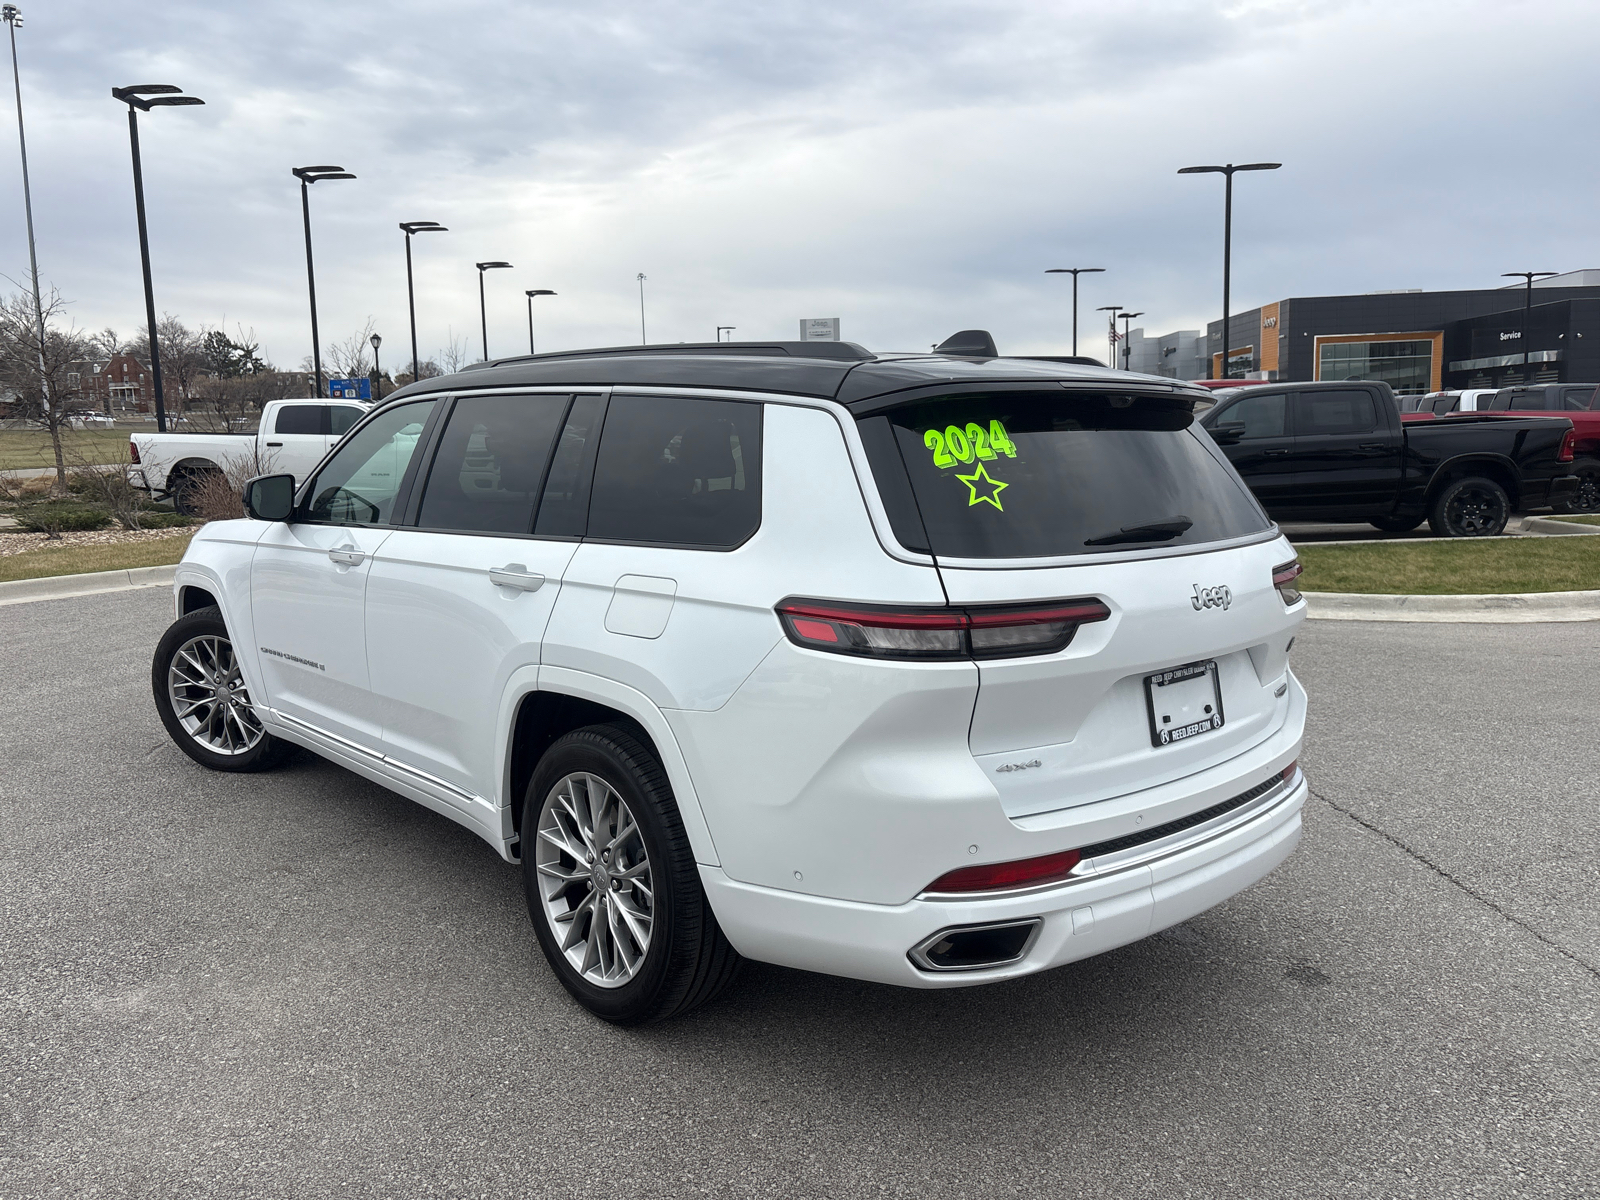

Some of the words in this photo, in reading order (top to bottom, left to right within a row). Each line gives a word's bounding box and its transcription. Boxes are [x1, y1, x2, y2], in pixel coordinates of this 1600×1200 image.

[1500, 330, 1521, 341] Service
[924, 420, 1017, 469] 2024
[1190, 583, 1232, 611] Jeep
[1151, 674, 1163, 684] REED
[1163, 672, 1174, 681] JEEP
[1173, 667, 1194, 679] CHRYSLER
[1172, 720, 1211, 741] REEDJEEP.COM
[995, 759, 1042, 772] 4x4
